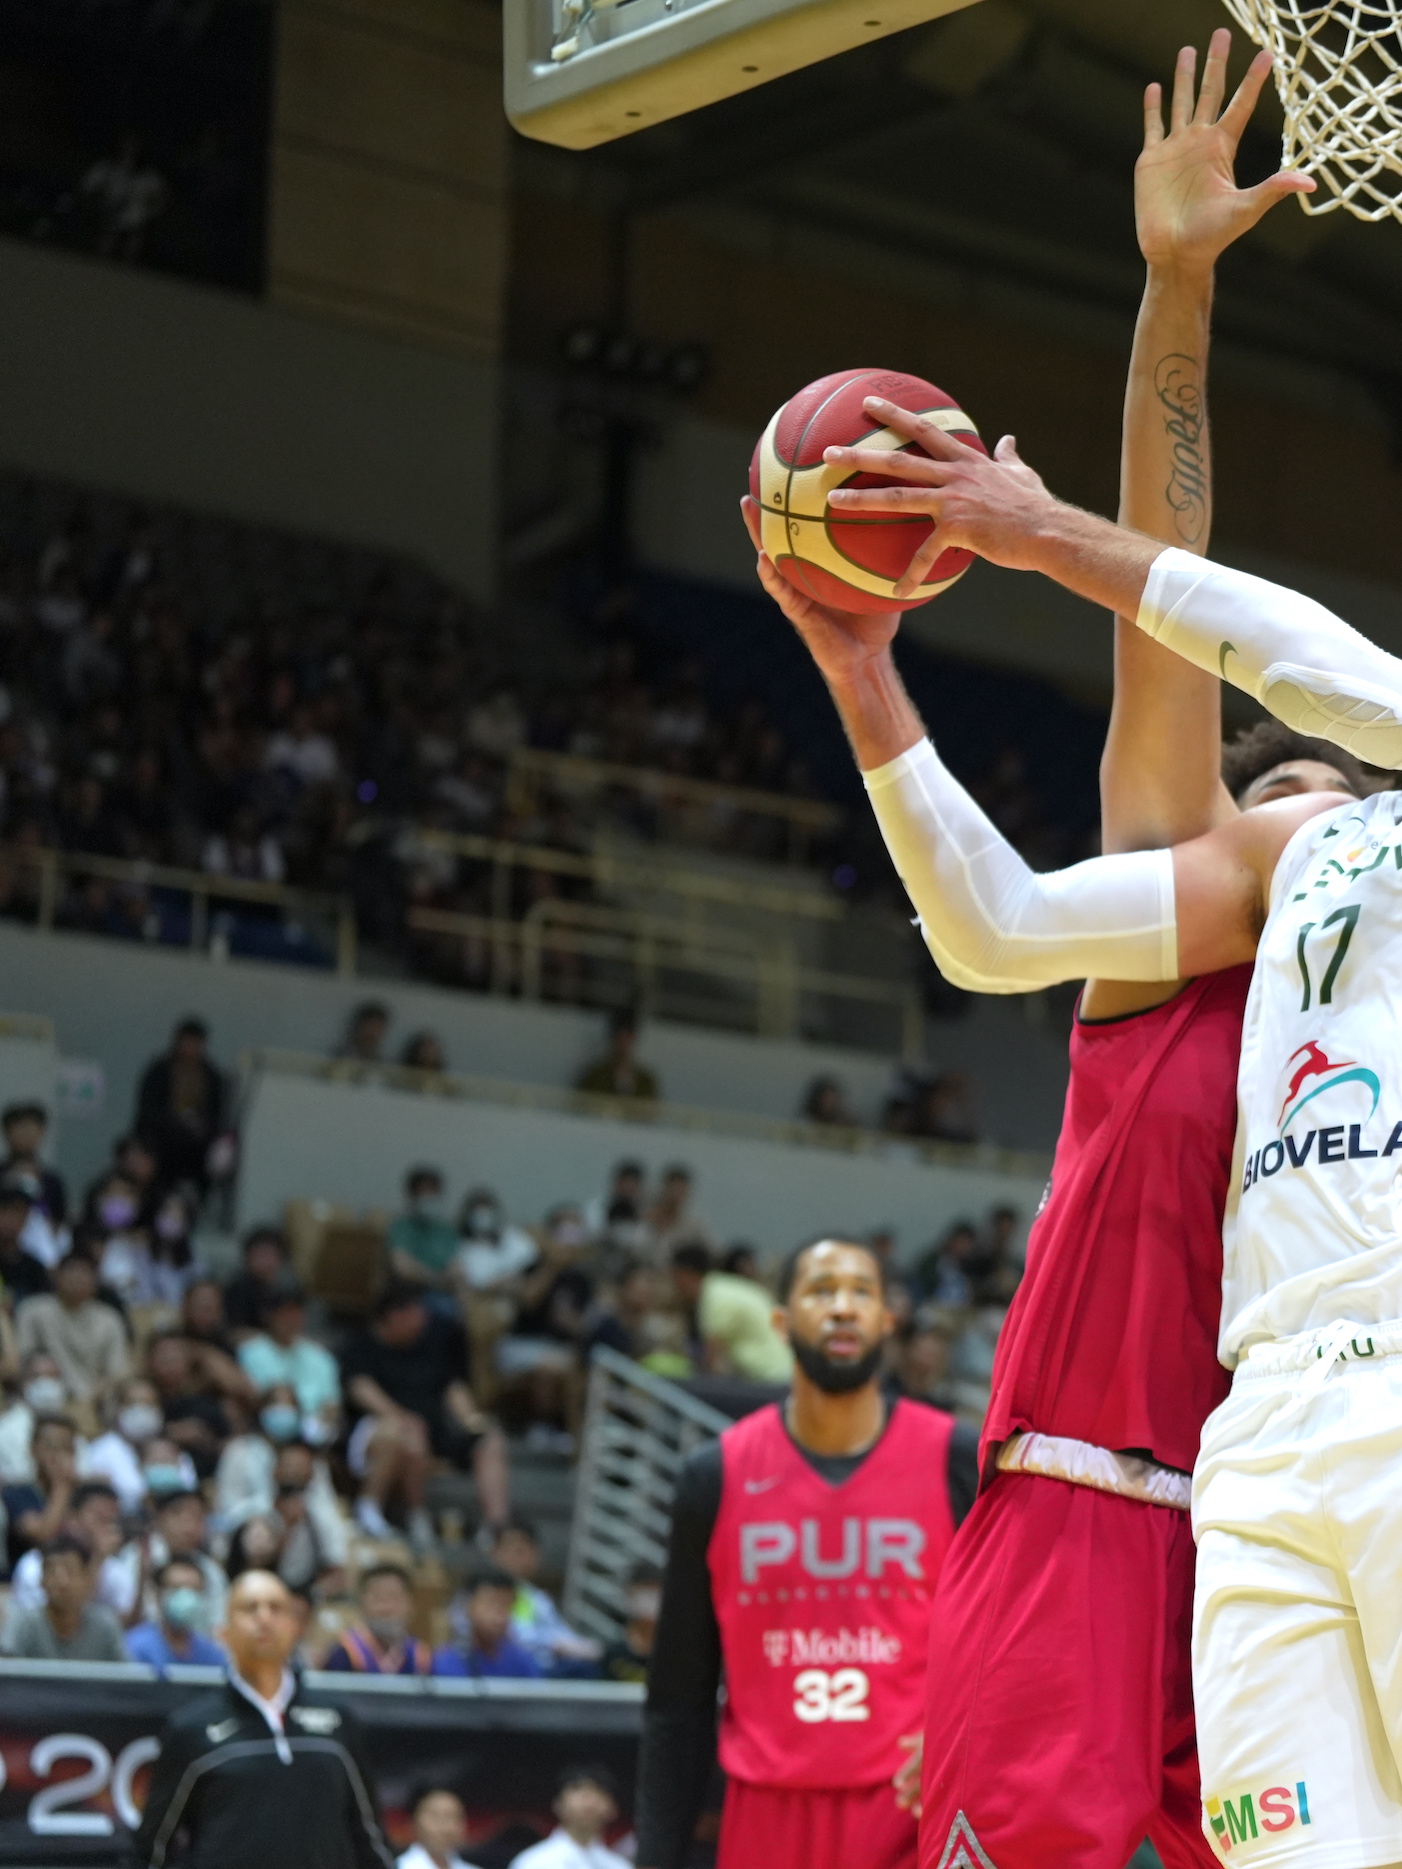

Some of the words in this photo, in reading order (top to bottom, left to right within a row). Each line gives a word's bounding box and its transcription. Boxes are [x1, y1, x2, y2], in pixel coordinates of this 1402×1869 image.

[1297, 904, 1361, 1012] 17
[740, 1518, 925, 1583] PUR
[793, 1668, 870, 1722] 32
